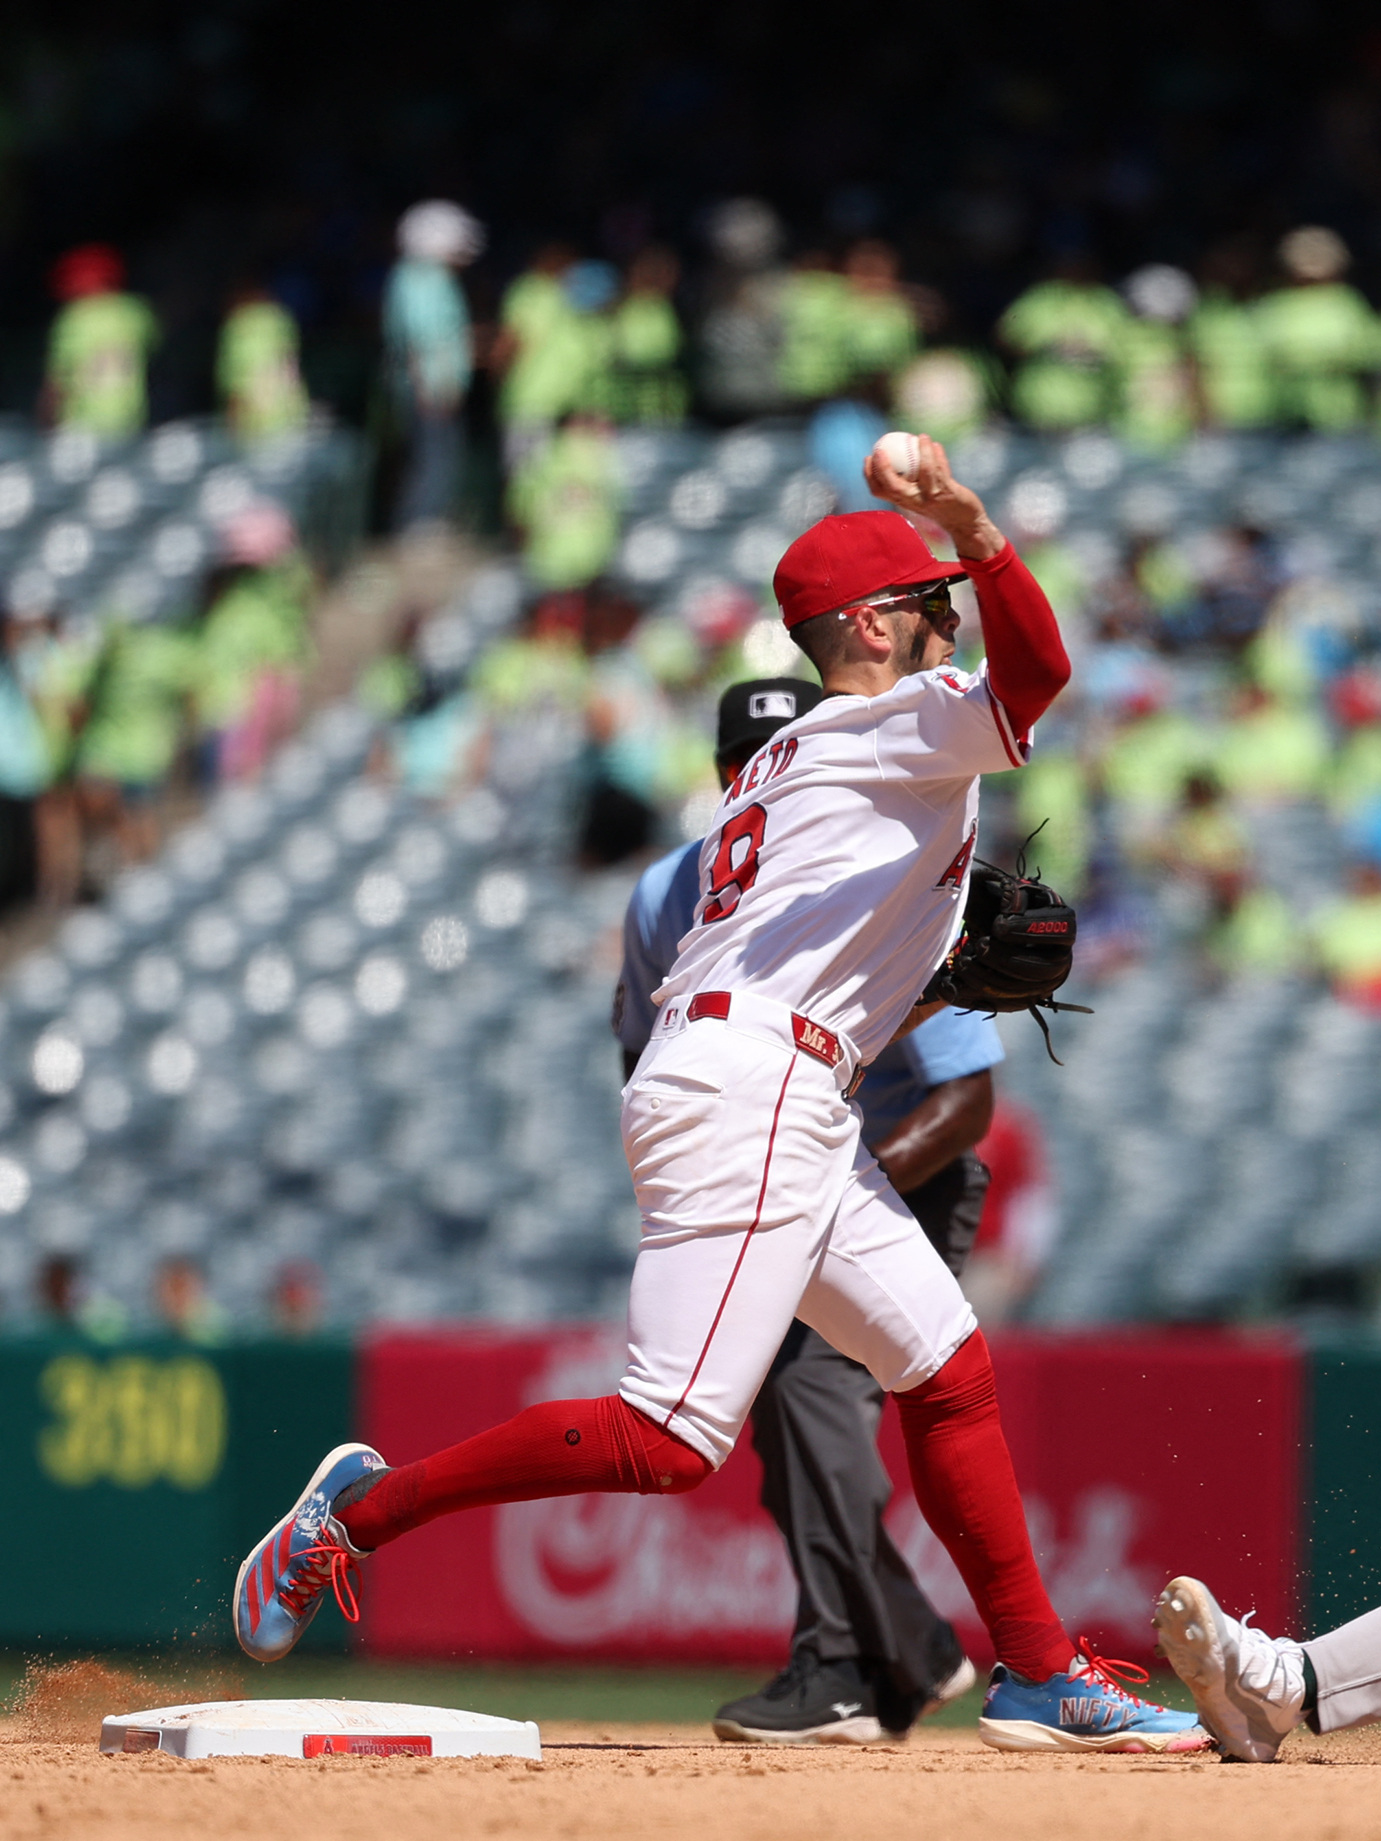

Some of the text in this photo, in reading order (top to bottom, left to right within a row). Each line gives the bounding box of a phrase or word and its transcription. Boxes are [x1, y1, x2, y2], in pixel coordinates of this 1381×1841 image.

[724, 737, 798, 807] NETO
[702, 802, 767, 925] 9
[1026, 921, 1069, 933] A2000
[799, 1021, 827, 1055] Mr.
[1059, 1697, 1139, 1729] NIFTY
